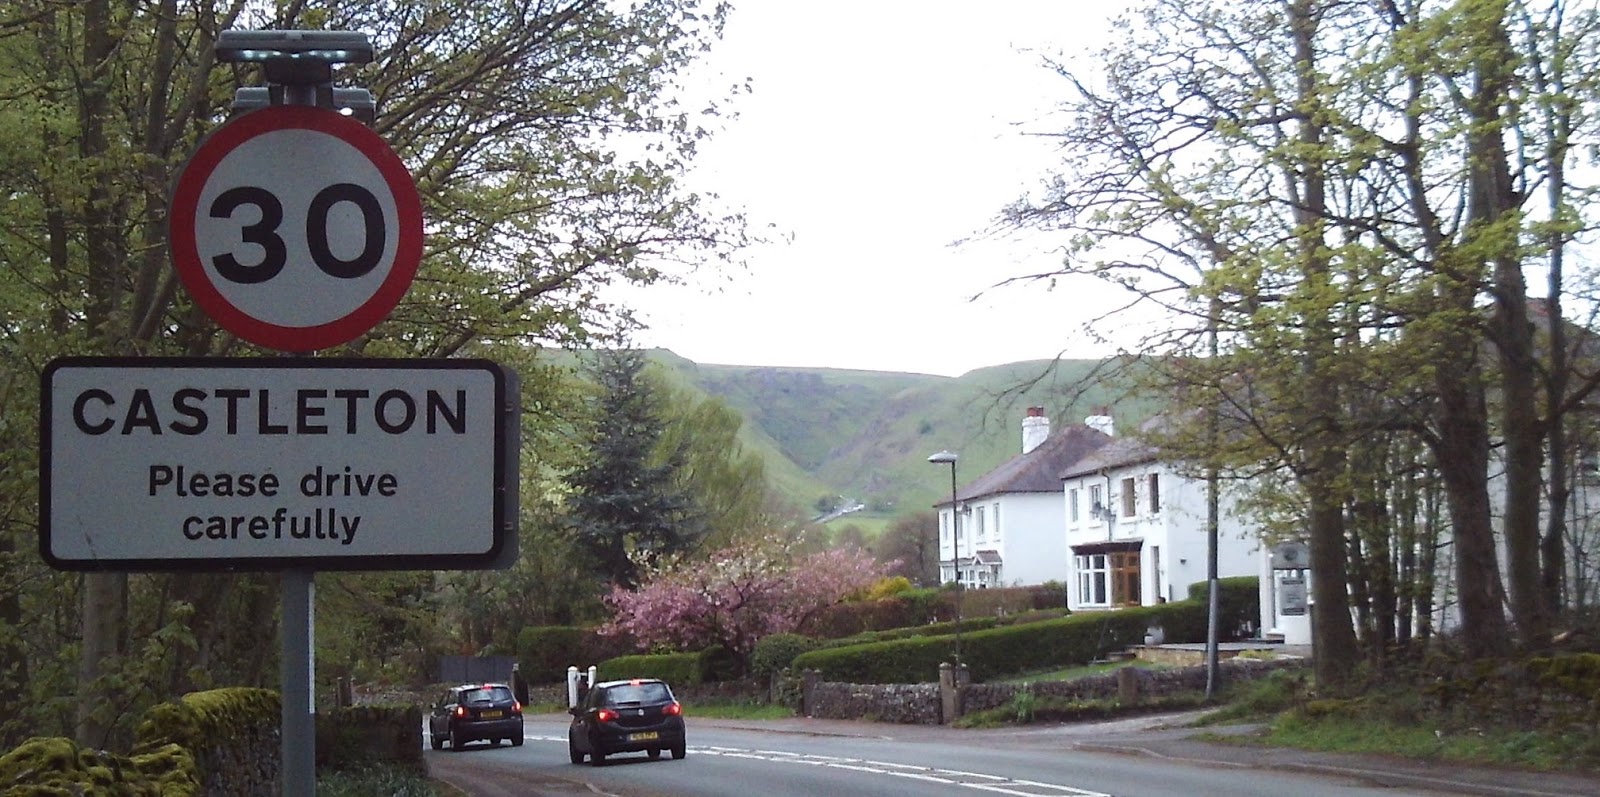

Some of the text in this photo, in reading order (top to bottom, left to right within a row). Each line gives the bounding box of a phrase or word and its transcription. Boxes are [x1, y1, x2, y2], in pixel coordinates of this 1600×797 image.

[208, 183, 386, 284] 30
[72, 387, 467, 436] CASTLETON
[148, 464, 398, 497] Please drive
[182, 507, 362, 546] carefully
